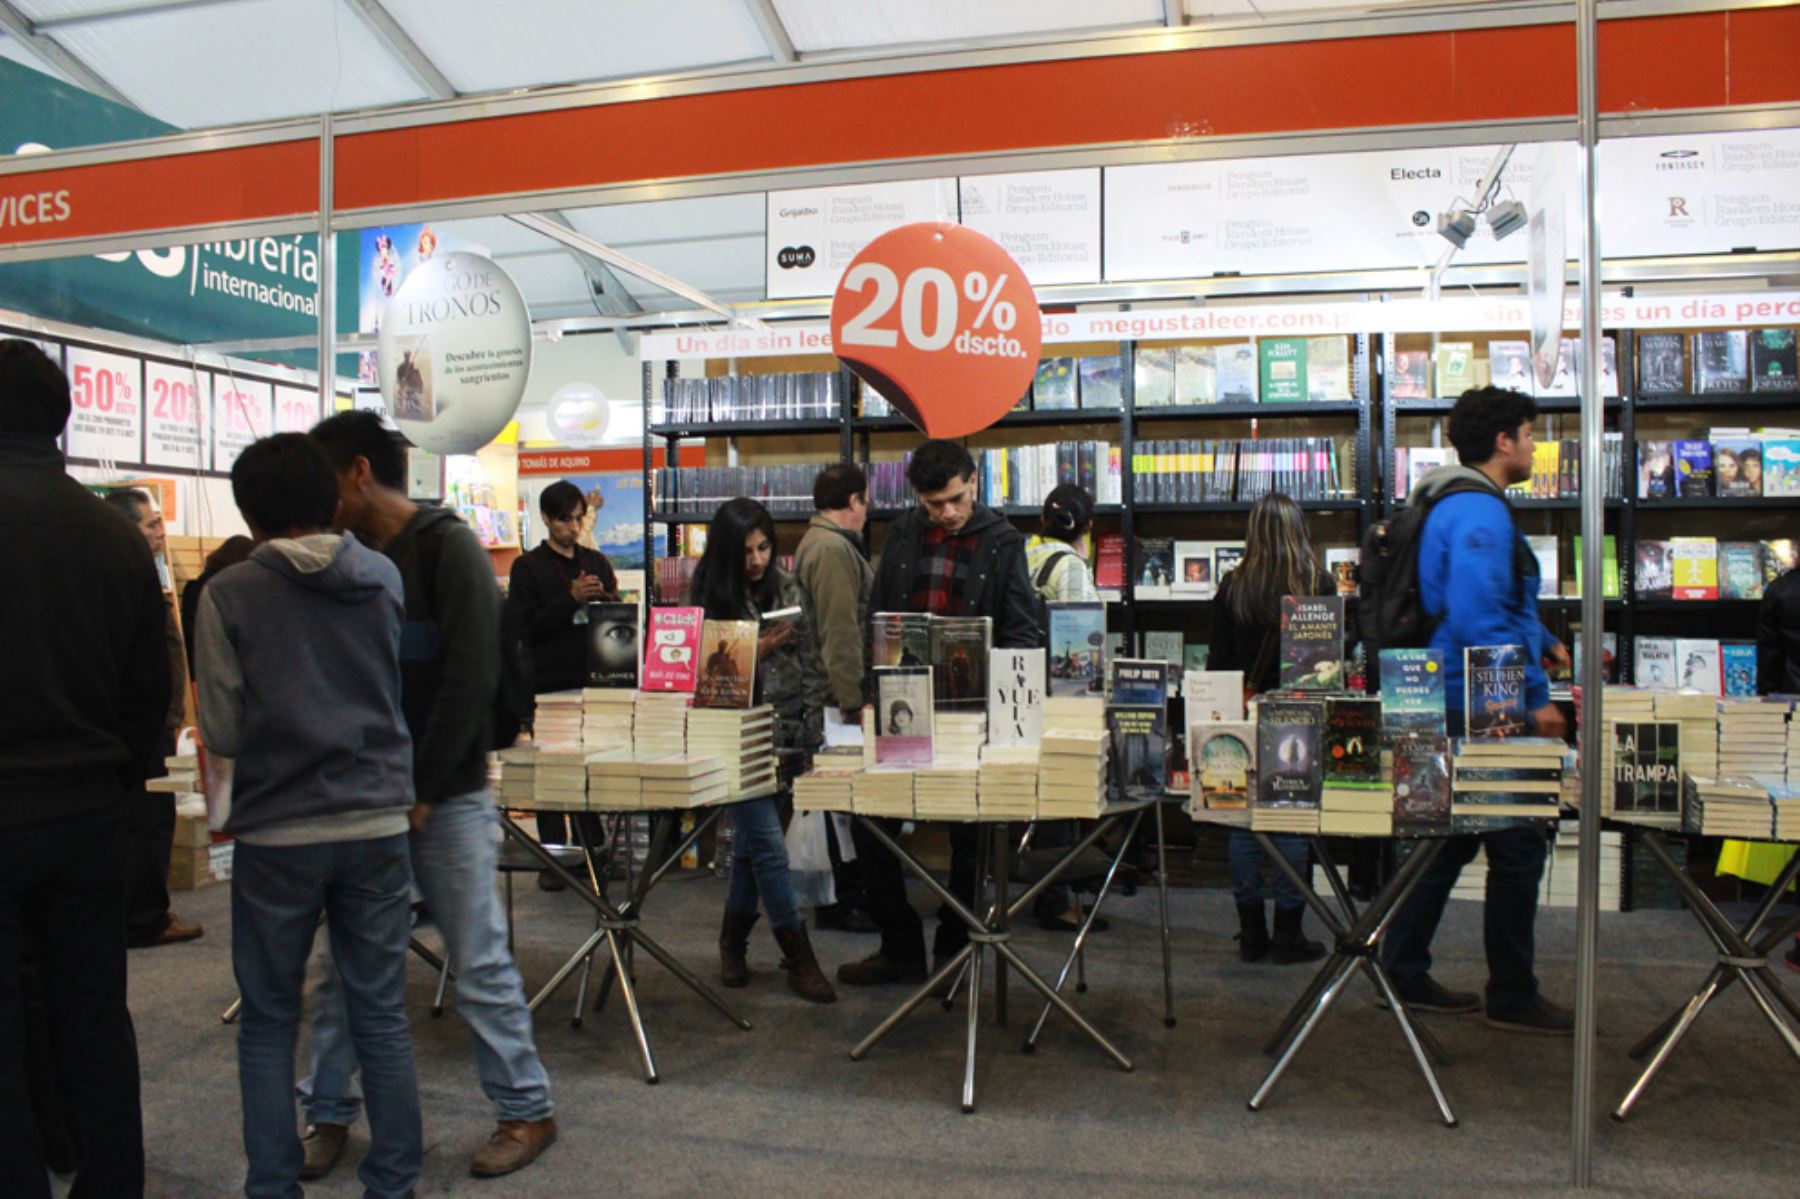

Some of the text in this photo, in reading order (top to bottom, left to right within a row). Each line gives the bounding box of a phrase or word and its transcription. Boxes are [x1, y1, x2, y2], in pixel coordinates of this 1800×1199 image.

[1390, 167, 1442, 180] Electa
[203, 235, 318, 283] brería
[203, 262, 319, 317] internacional
[402, 289, 502, 326] TRONOS
[841, 261, 1017, 352] 20%
[1636, 303, 1672, 320] un
[676, 335, 708, 353] Un
[757, 331, 792, 349] sin
[799, 330, 833, 348] lee
[1089, 310, 1351, 338] megustaleer.com.p
[954, 329, 1028, 359] dscto.
[74, 363, 133, 413] 50%
[1290, 612, 1336, 622] ALLENDE
[1402, 664, 1422, 672] QUE
[1476, 669, 1526, 683] STEPHEN
[1482, 682, 1520, 698] KING
[1615, 733, 1636, 752] LA
[1615, 764, 1678, 783] TRAMPA
